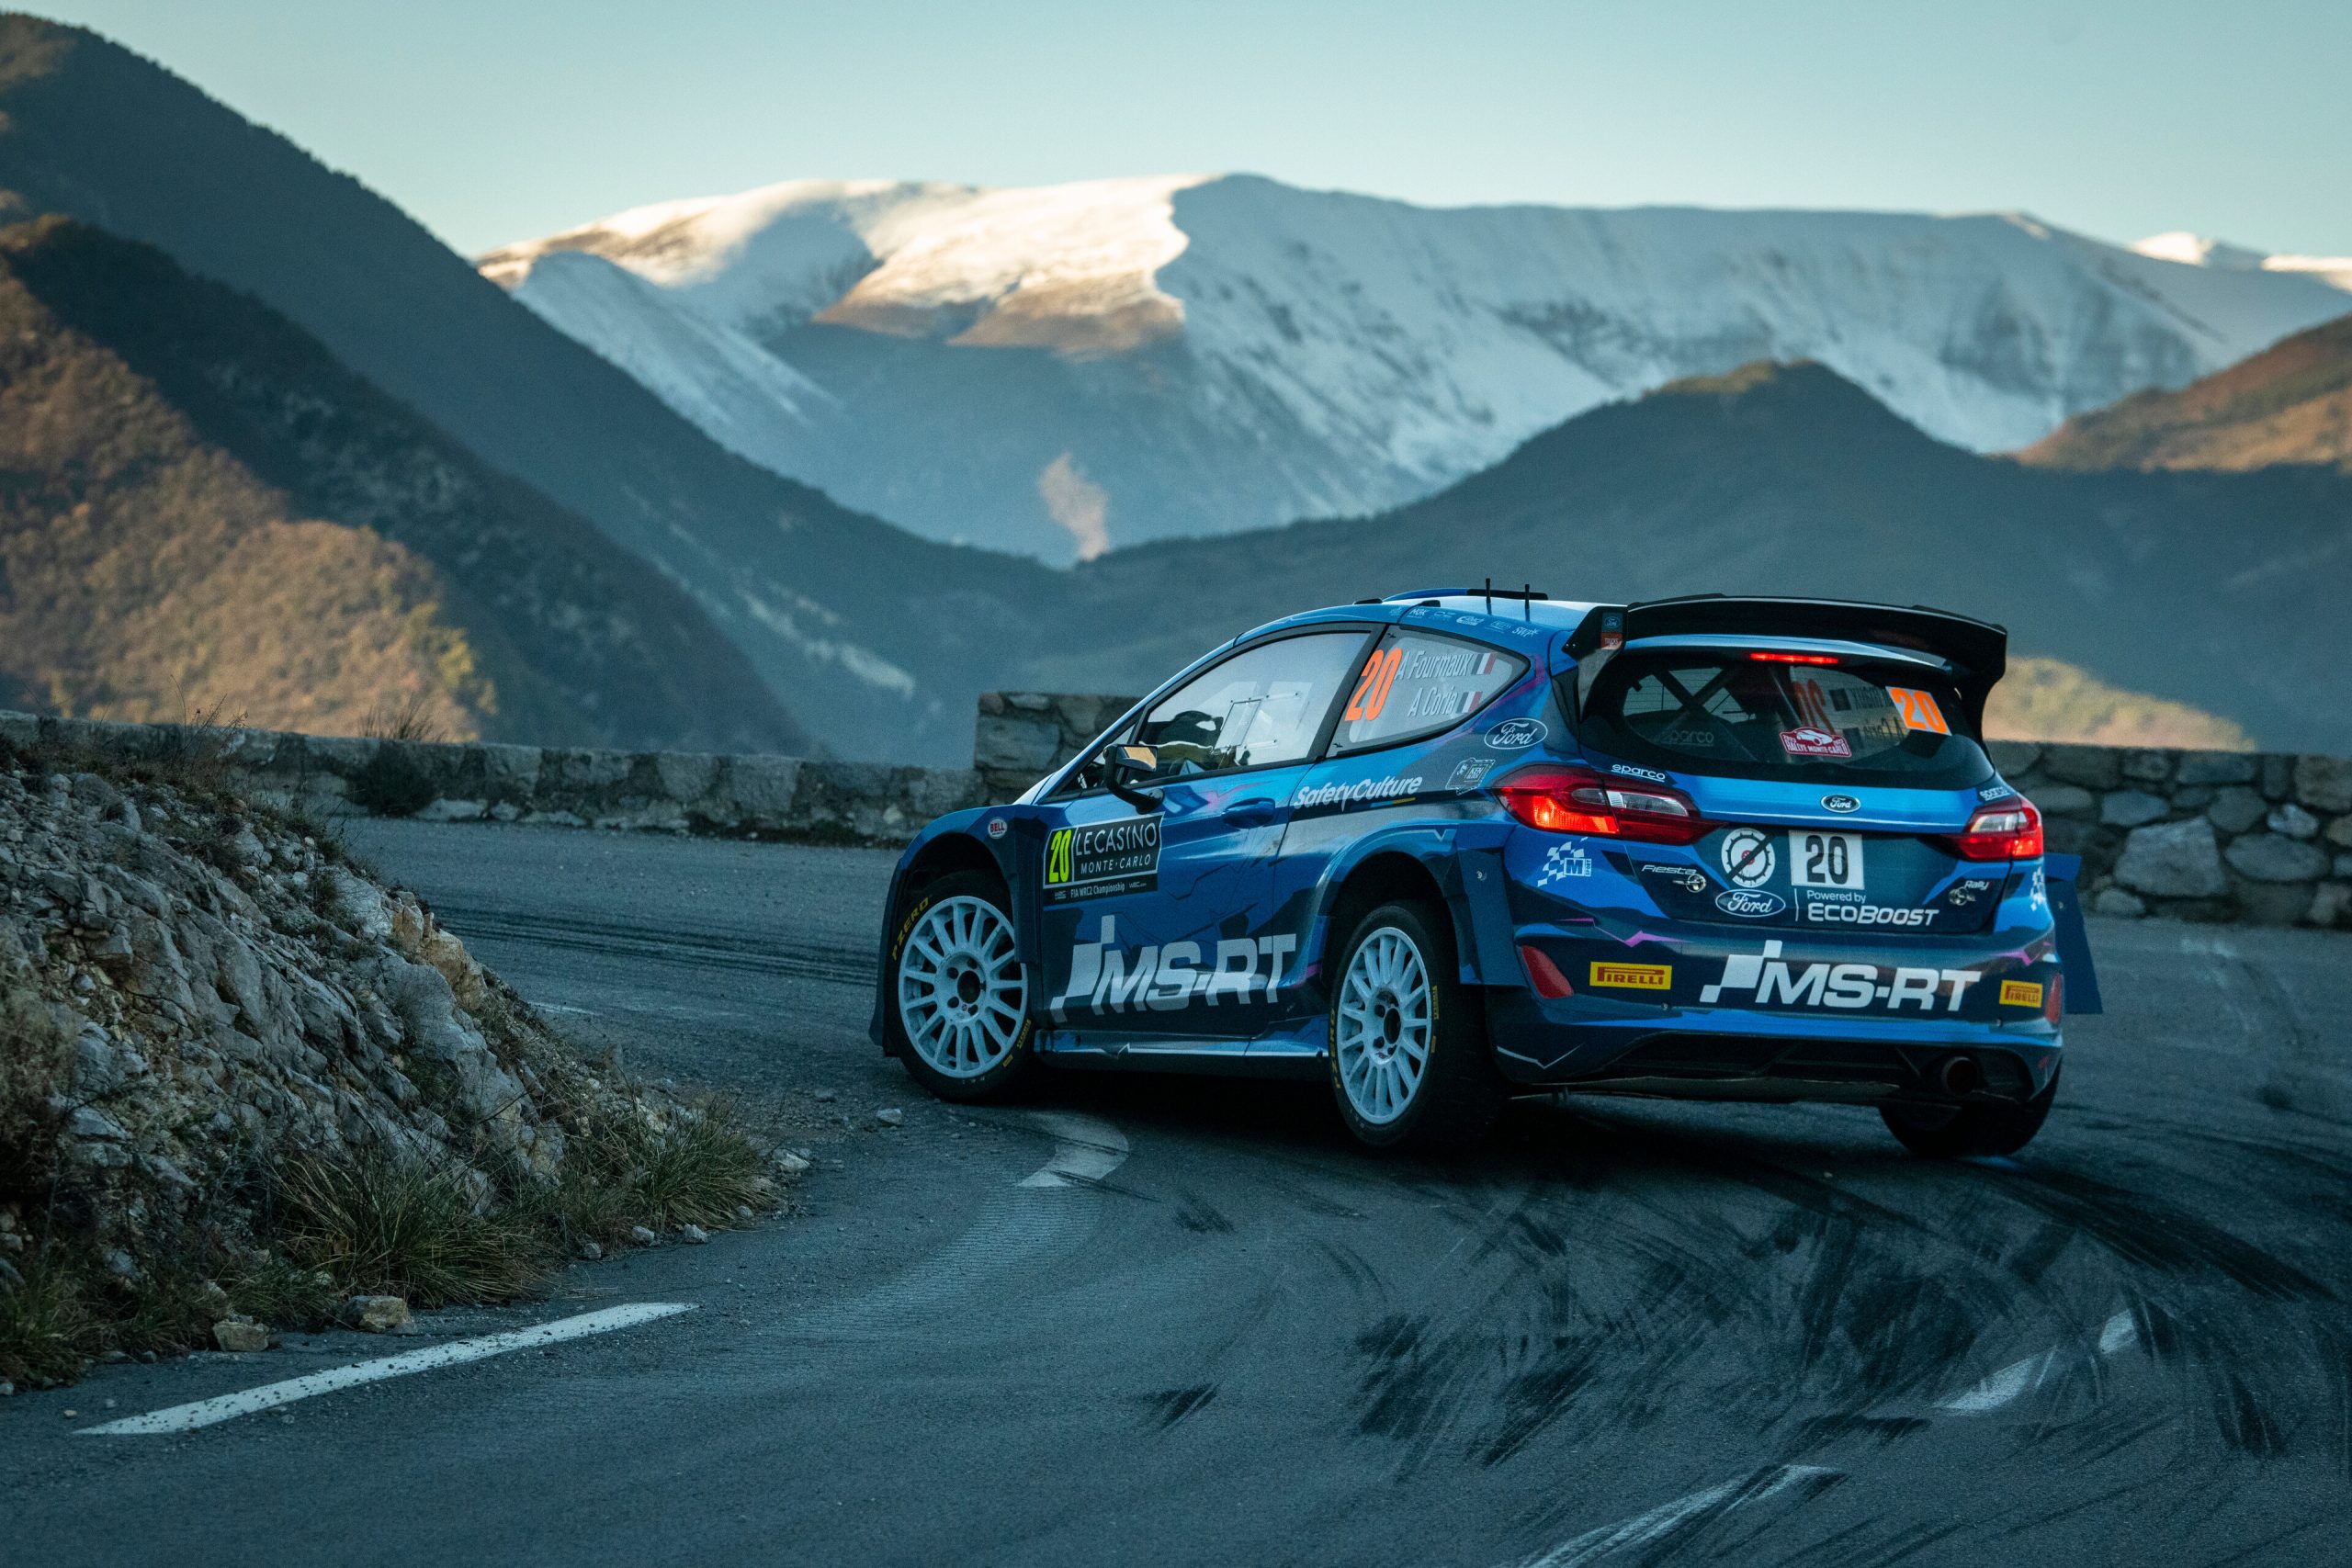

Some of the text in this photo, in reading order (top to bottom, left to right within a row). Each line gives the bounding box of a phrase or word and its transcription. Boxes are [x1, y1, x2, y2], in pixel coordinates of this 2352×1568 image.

[1394, 650, 1474, 681] A Fourmaux
[1345, 647, 1402, 721] 20
[1407, 685, 1460, 717] A Coria
[1890, 686, 1949, 734] 20
[1491, 722, 1533, 746] Ford
[1611, 763, 1666, 781] sparco
[1294, 775, 1423, 812] SafetyCulture
[1829, 797, 1851, 809] Ford
[990, 822, 1005, 833] BELL
[1049, 829, 1072, 883] 20
[1566, 859, 1583, 875] M
[1804, 834, 1849, 885] 20
[1093, 882, 1125, 896] Championship
[1727, 892, 1772, 913] Ford
[1806, 889, 1867, 904] Powered by
[897, 897, 929, 947] ZERO
[1092, 933, 1297, 1016] MS-RT
[1597, 966, 1665, 985] PIRELLI
[1755, 961, 1981, 1010] MS-RT
[2005, 985, 2041, 1003] PIRELLI
